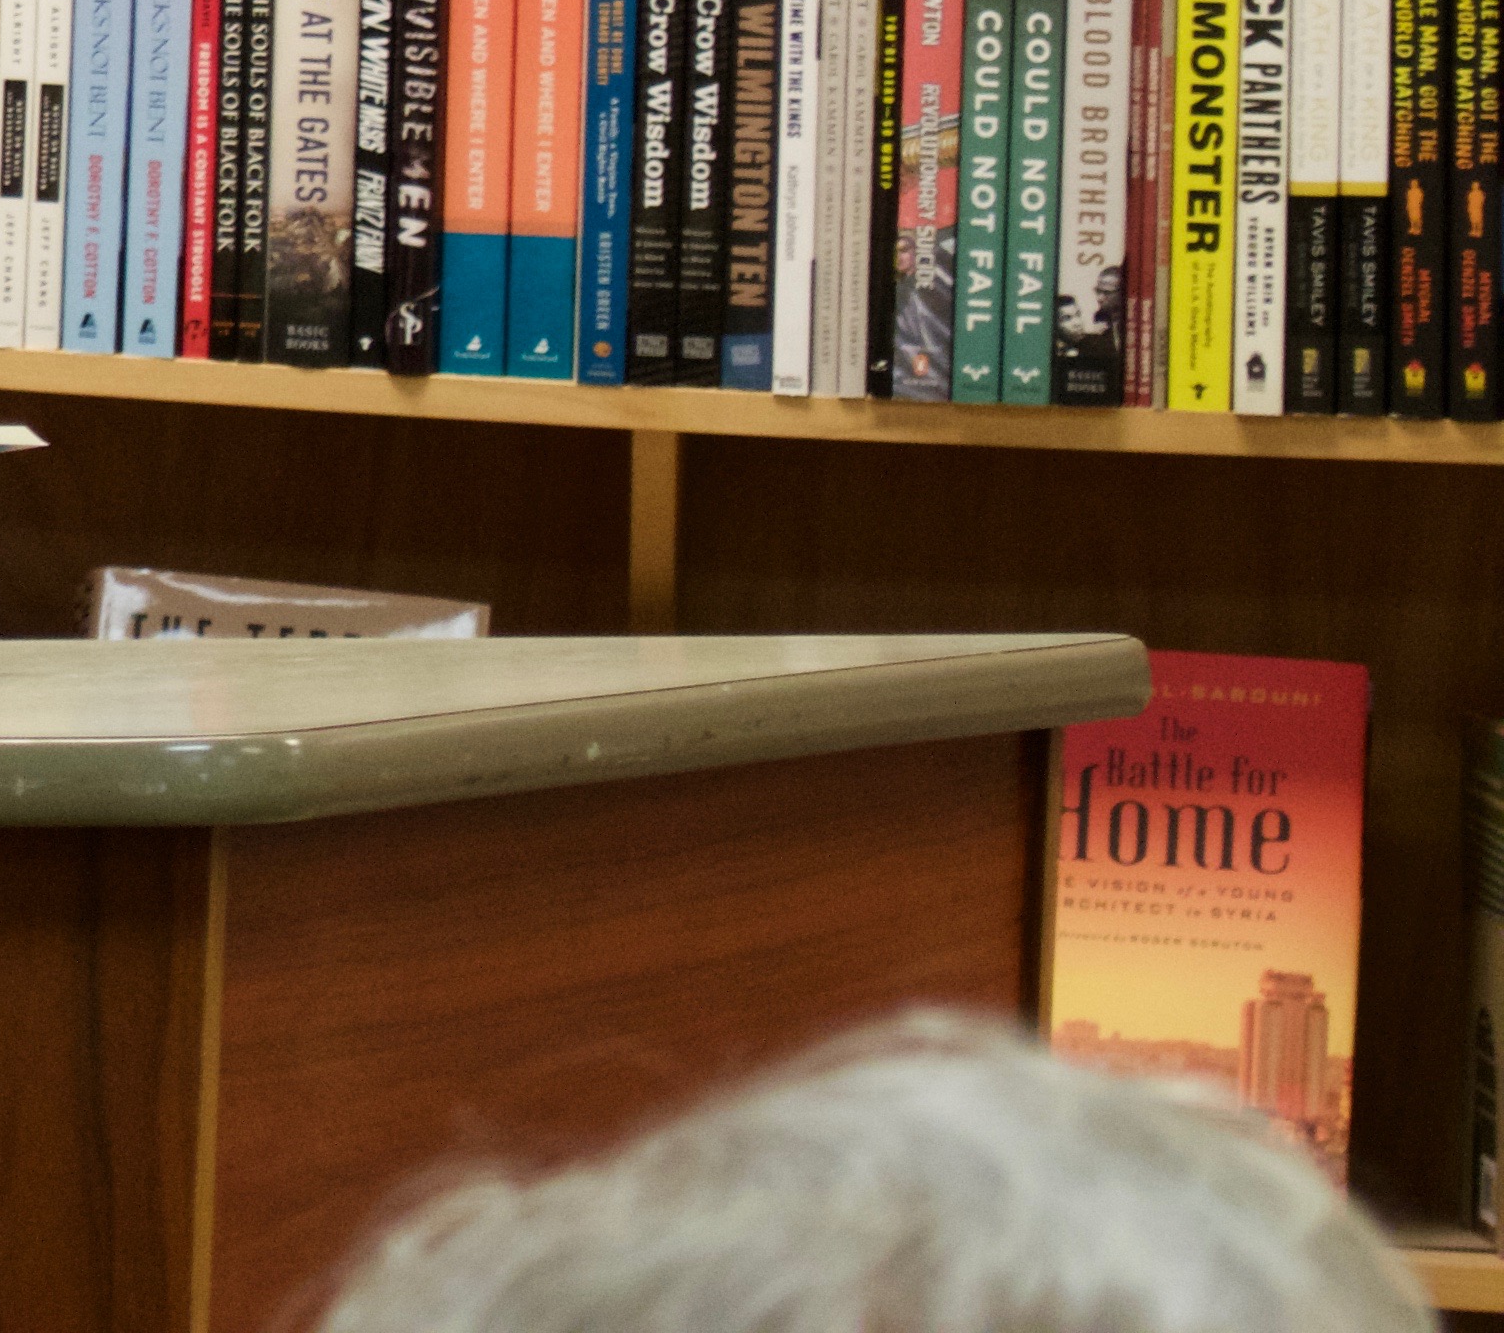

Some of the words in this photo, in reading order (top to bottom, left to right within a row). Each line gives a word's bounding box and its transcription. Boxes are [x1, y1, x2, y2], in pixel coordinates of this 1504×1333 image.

[975, 11, 1003, 141] COULD
[1182, 0, 1229, 256] MONSTER
[1238, 61, 1282, 205] PANTHERS
[968, 156, 998, 234] NOT
[962, 247, 1000, 333] FAIL
